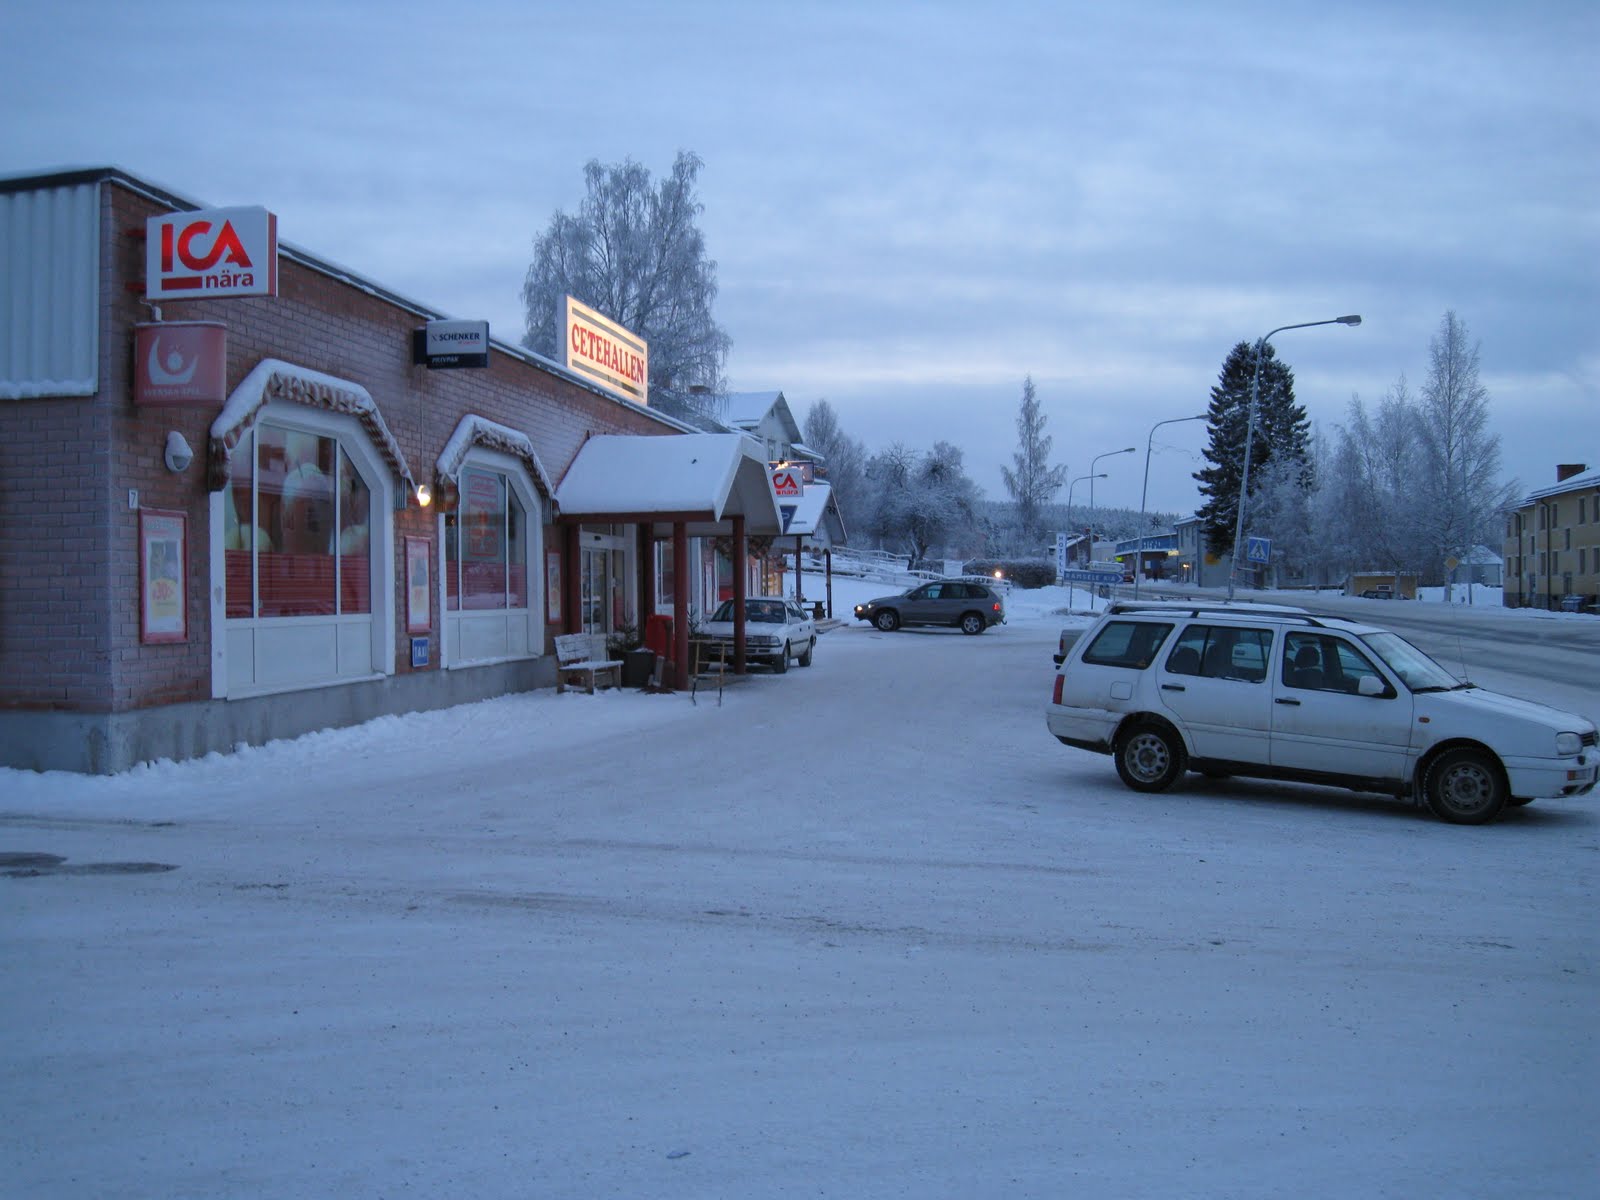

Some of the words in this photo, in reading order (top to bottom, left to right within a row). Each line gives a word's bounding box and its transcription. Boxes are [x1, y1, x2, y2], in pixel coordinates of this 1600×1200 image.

[161, 219, 253, 273] ICA
[205, 270, 254, 289] nära
[438, 332, 481, 342] SCHENKER
[571, 323, 644, 385] CETEHALLEN
[772, 472, 798, 489] CA
[414, 646, 427, 657] TAXI
